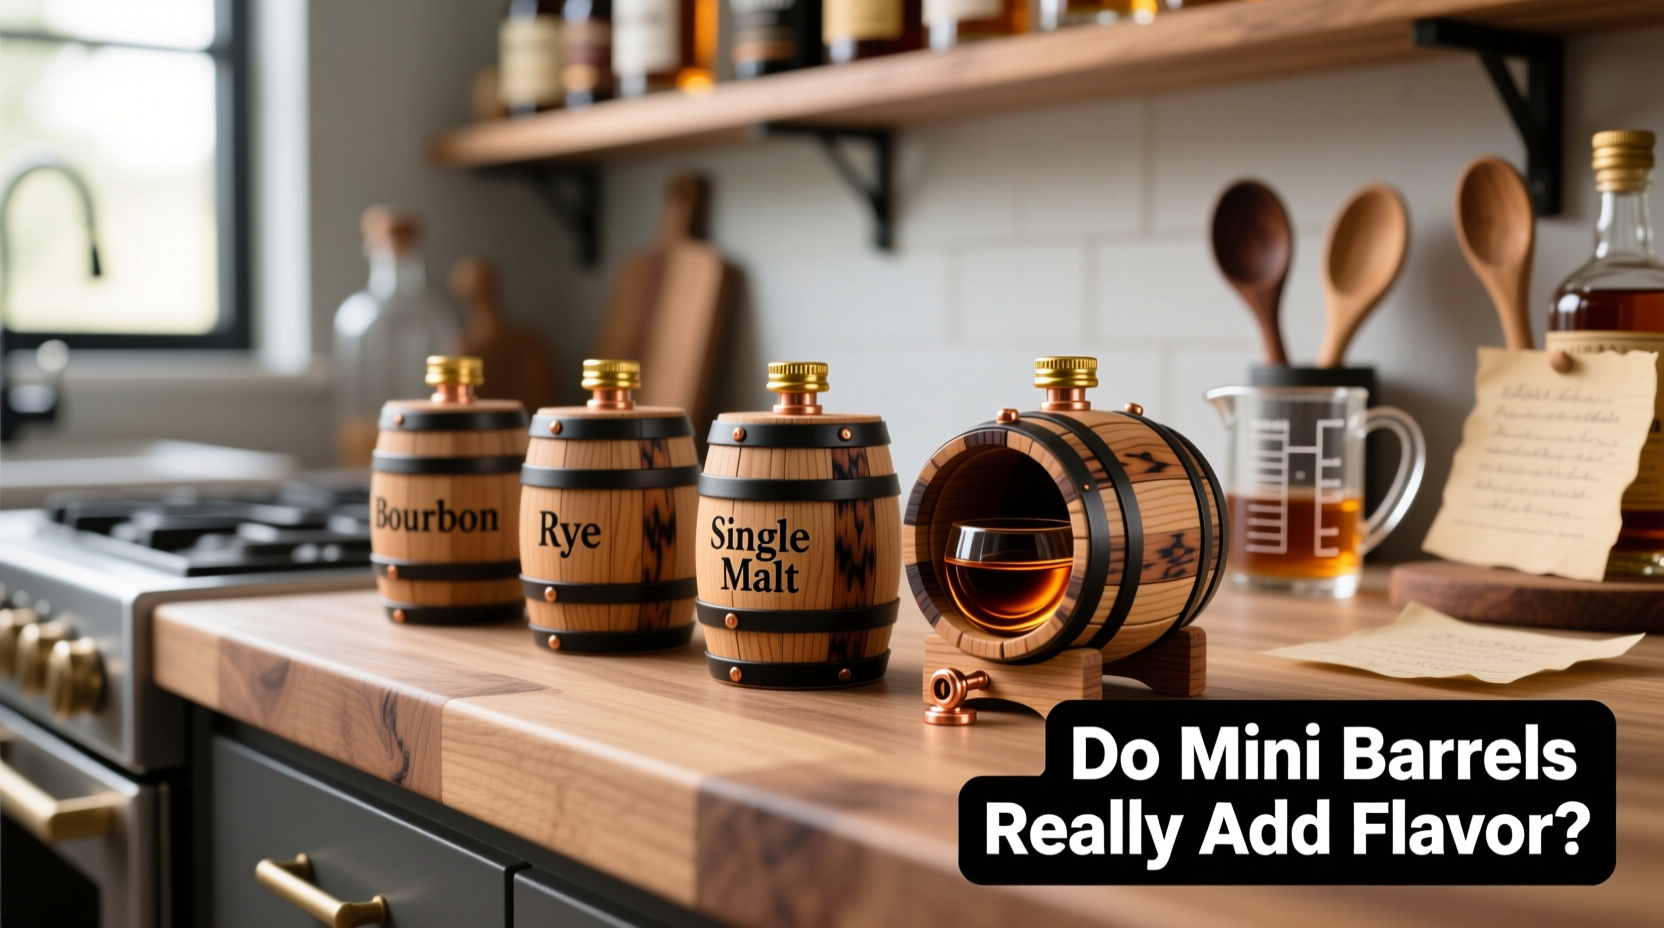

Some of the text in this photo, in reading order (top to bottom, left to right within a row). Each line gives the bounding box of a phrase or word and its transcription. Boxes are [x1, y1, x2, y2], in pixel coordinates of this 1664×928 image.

[375, 498, 499, 533] Bourbon
[539, 511, 602, 559] Rye
[711, 515, 811, 562] Single
[720, 557, 800, 594] Malt
